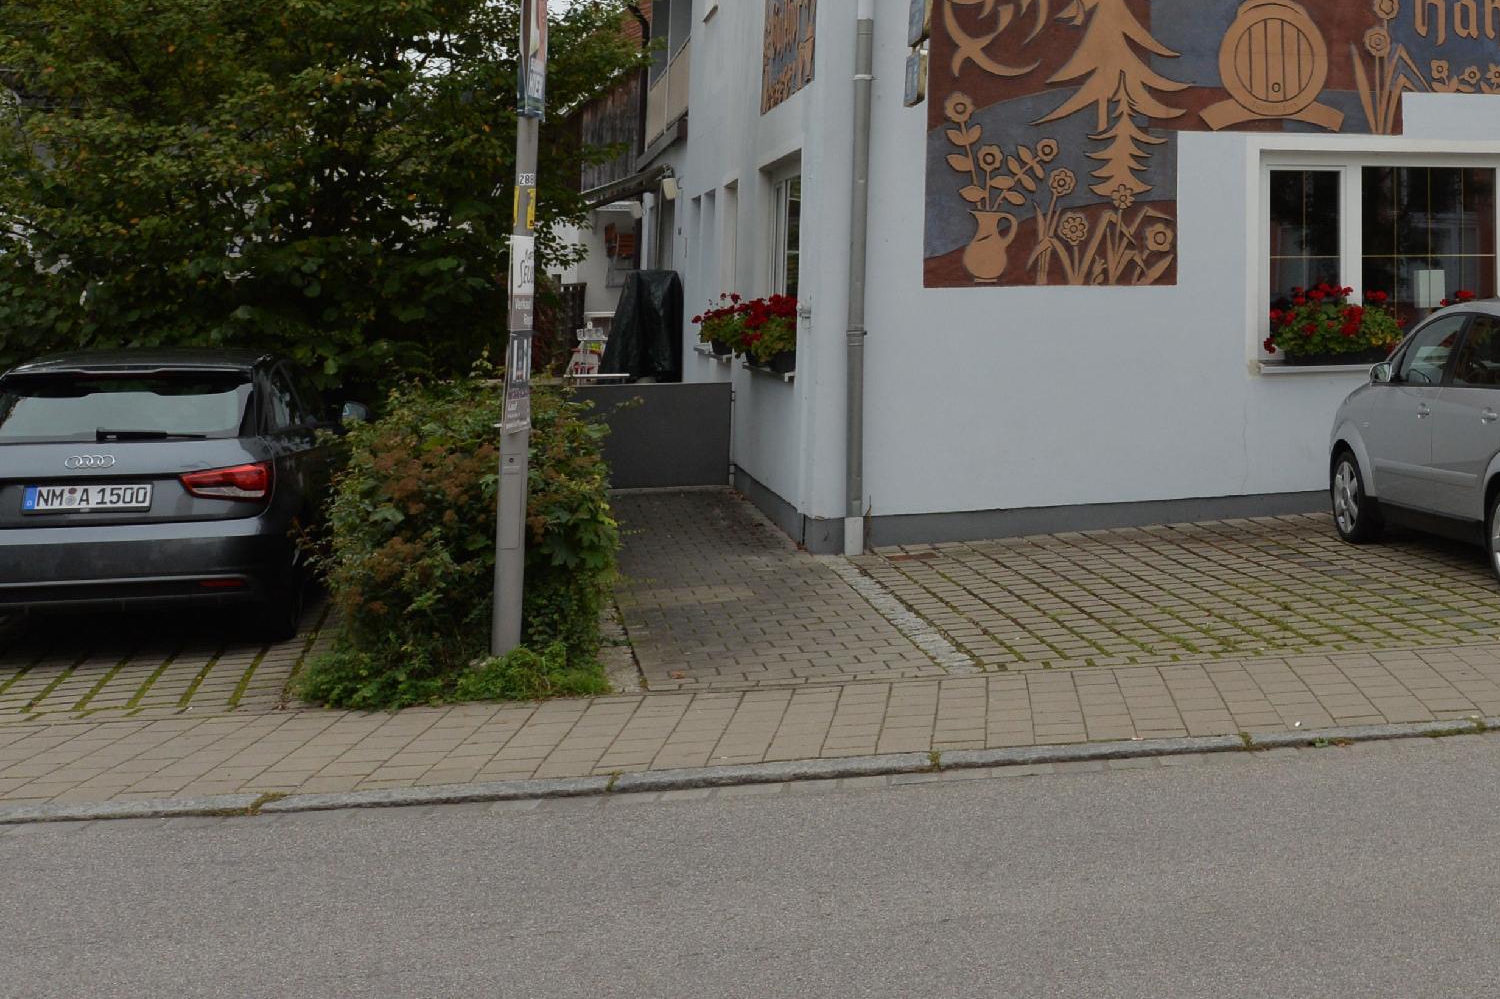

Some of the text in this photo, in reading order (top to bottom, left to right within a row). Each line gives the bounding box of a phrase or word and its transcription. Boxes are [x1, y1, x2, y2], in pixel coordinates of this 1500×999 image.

[36, 488, 65, 507] NM
[77, 488, 91, 505] A
[95, 487, 148, 506] 1500
